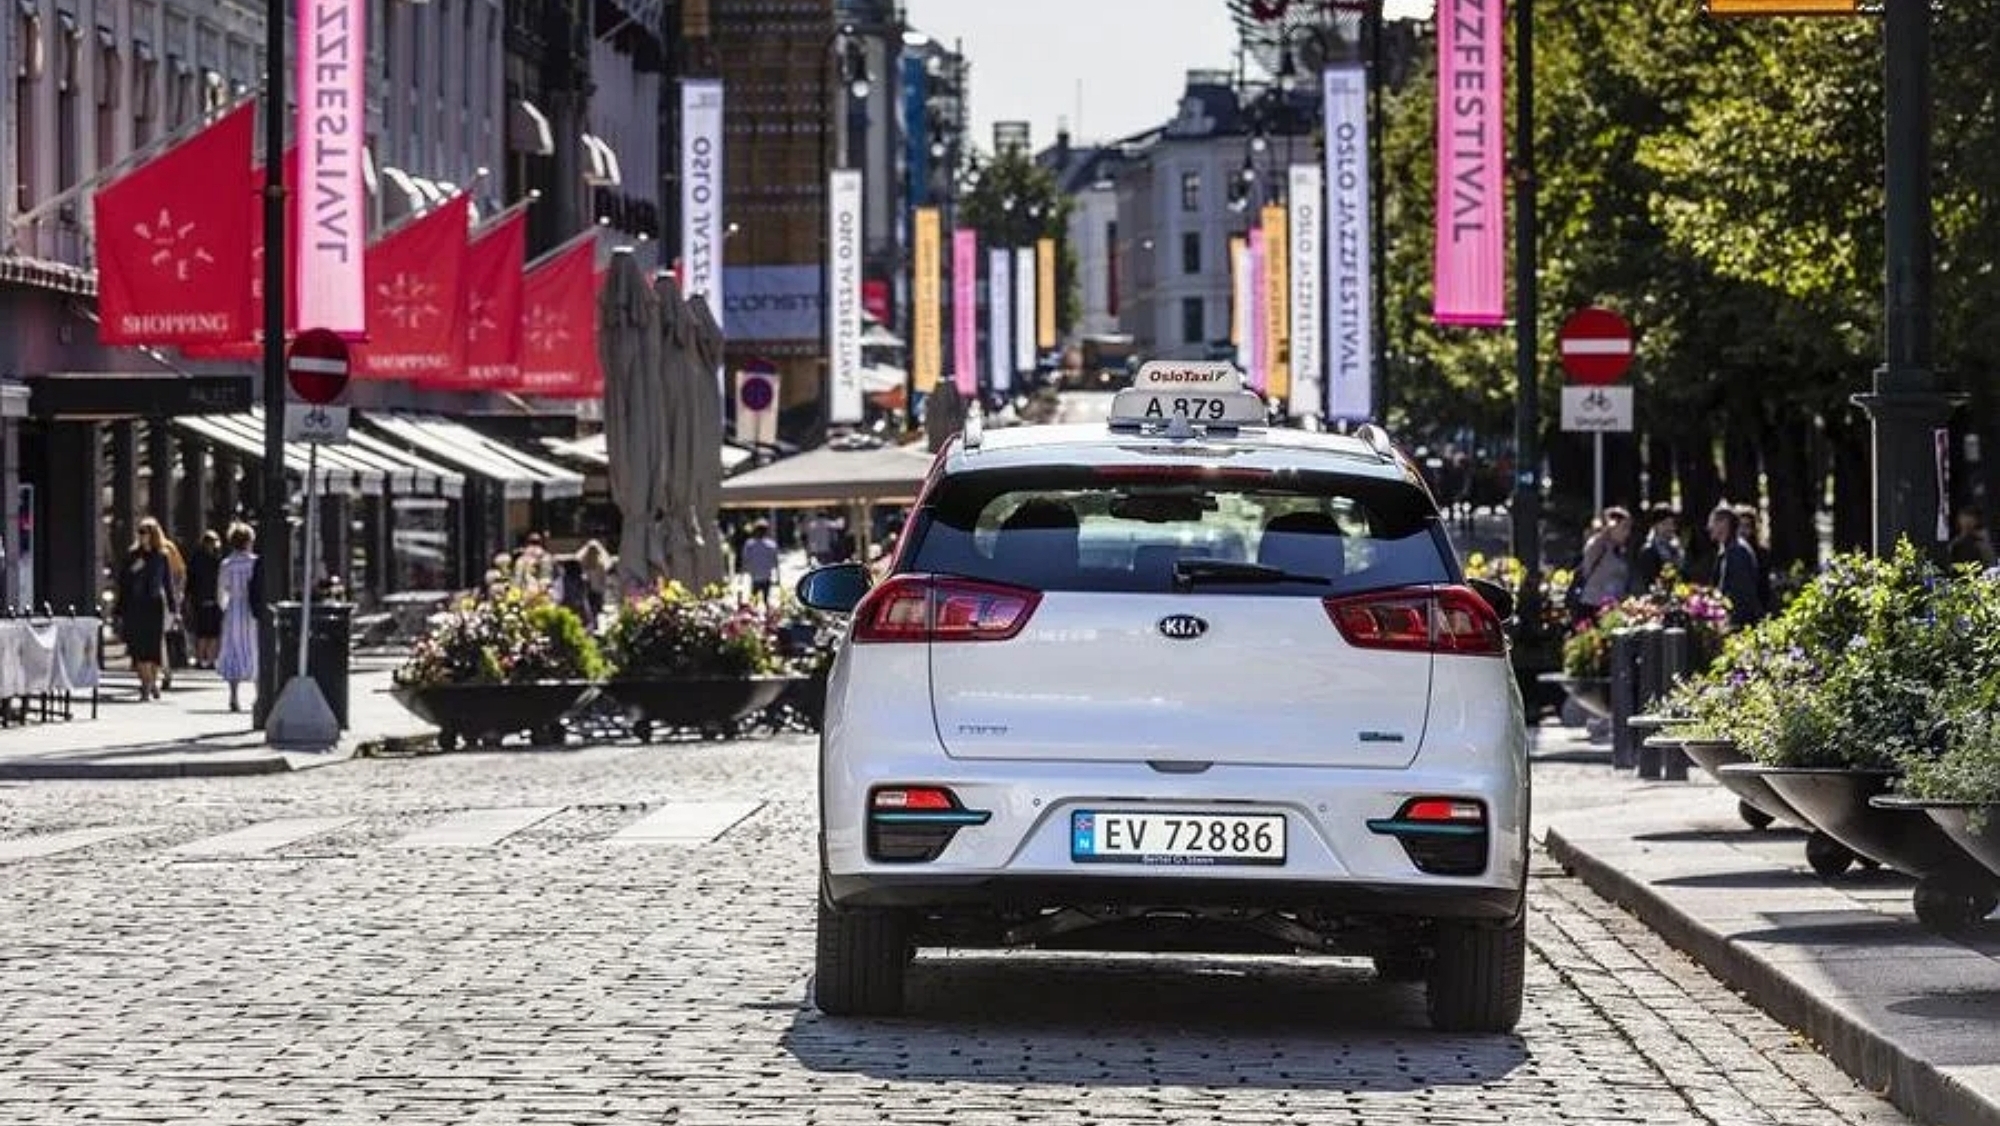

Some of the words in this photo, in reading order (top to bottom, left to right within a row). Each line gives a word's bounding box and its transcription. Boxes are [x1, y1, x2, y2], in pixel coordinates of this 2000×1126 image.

[1337, 122, 1356, 190] OSLO
[1300, 205, 1313, 252] OSLO
[1338, 198, 1360, 375] JAZZFESTIVAL
[122, 313, 229, 334] SHOPPING
[1150, 371, 1214, 382] OsloTaxi
[1146, 397, 1163, 418] A
[1173, 397, 1225, 419] 879
[1166, 619, 1200, 635] KIA
[1079, 838, 1090, 849] N
[1105, 819, 1147, 850] EV
[1163, 820, 1273, 852] 72886
